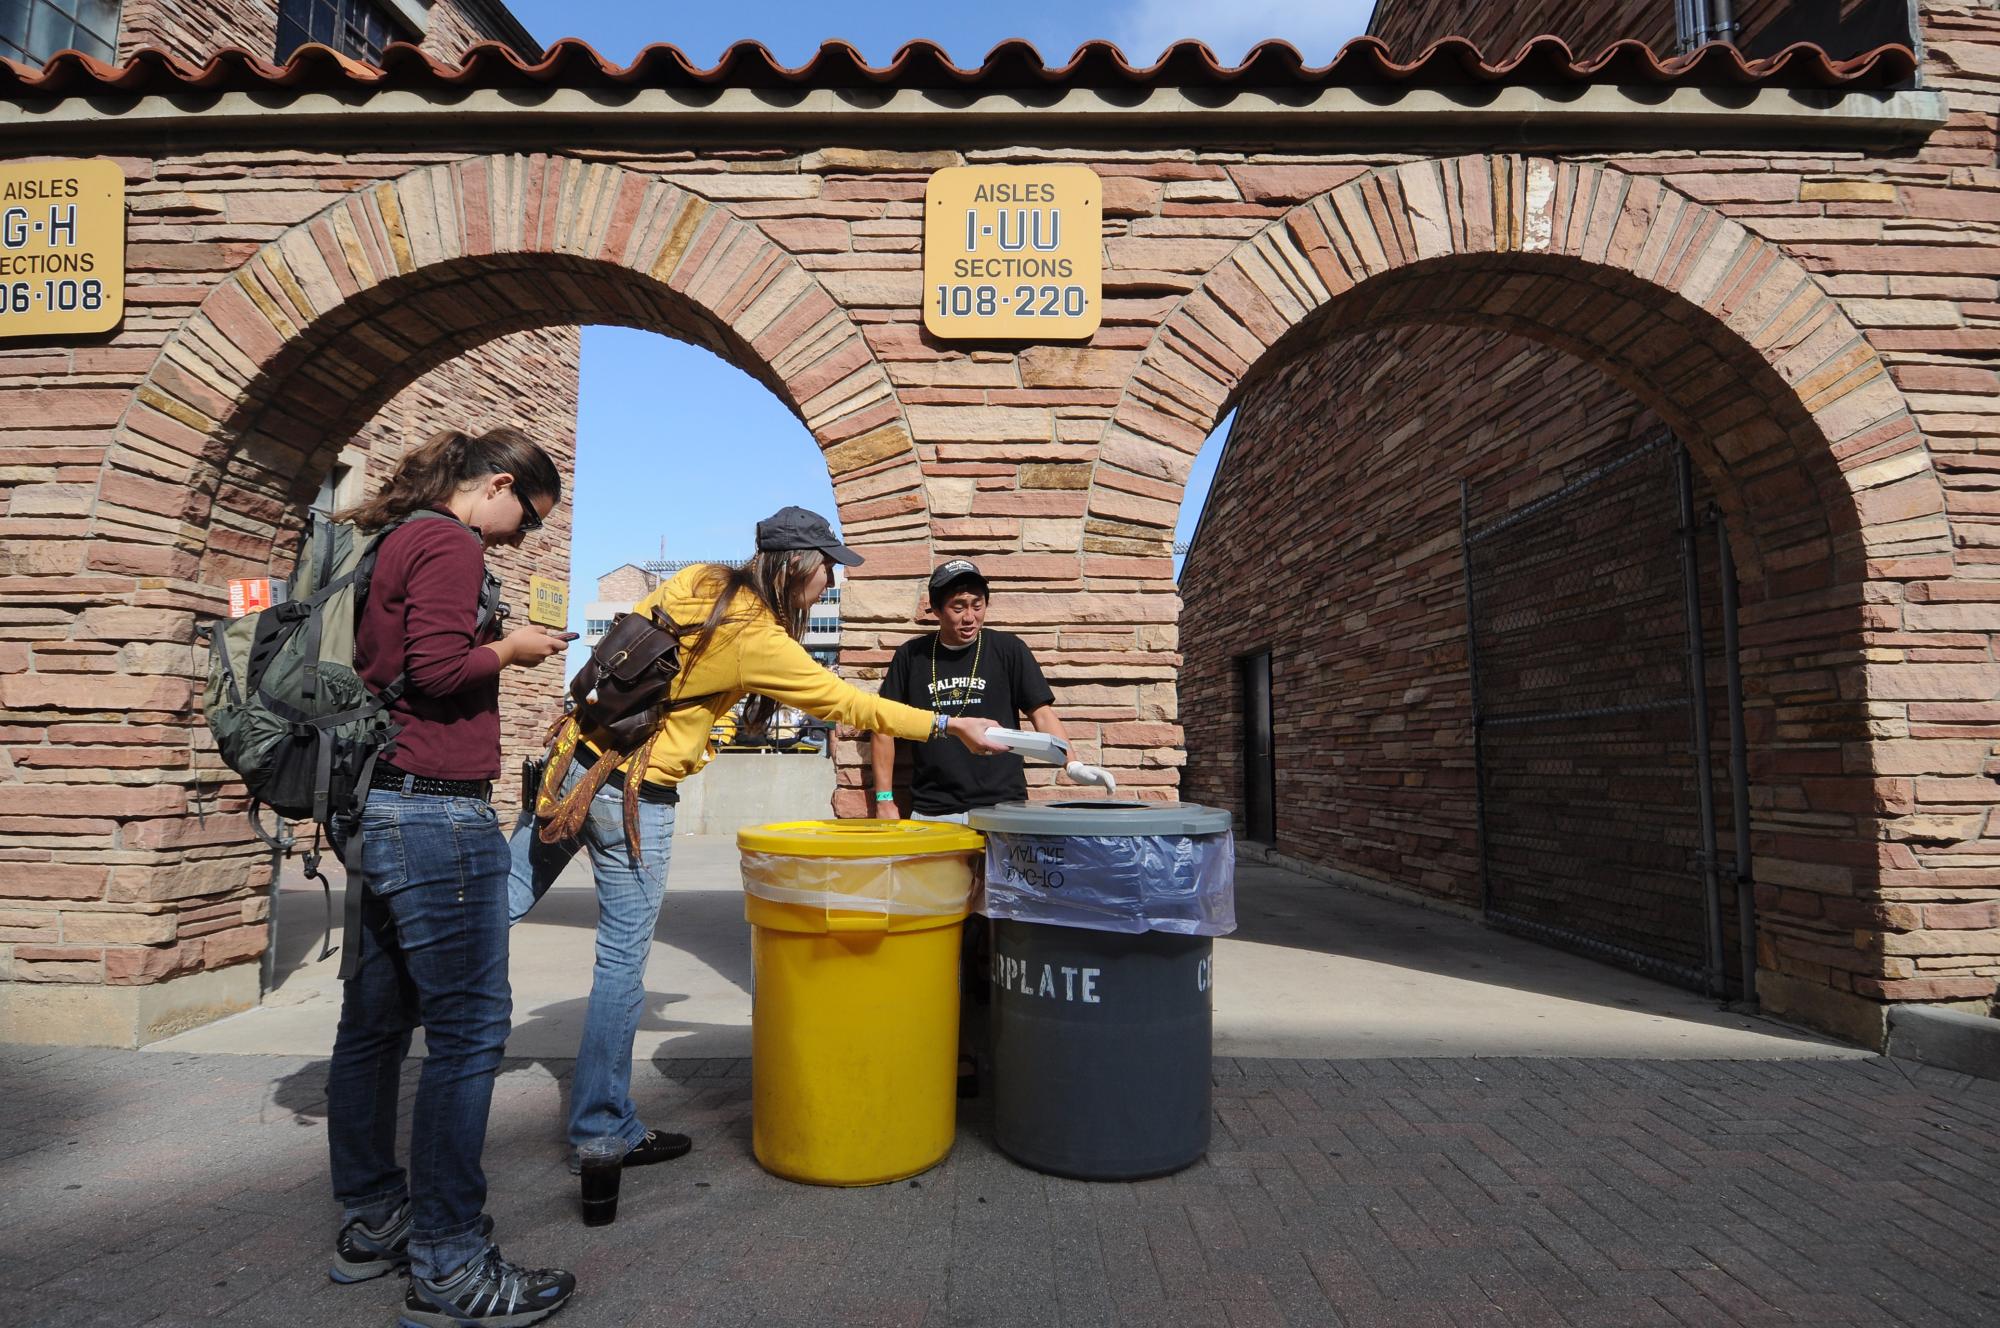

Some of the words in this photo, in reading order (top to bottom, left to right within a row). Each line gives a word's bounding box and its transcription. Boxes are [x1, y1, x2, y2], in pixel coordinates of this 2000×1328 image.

[3, 178, 79, 200] AISLES
[973, 183, 1055, 203] AISLES
[954, 258, 1073, 278] SECTIONS
[992, 953, 1101, 1003] RPLATE
